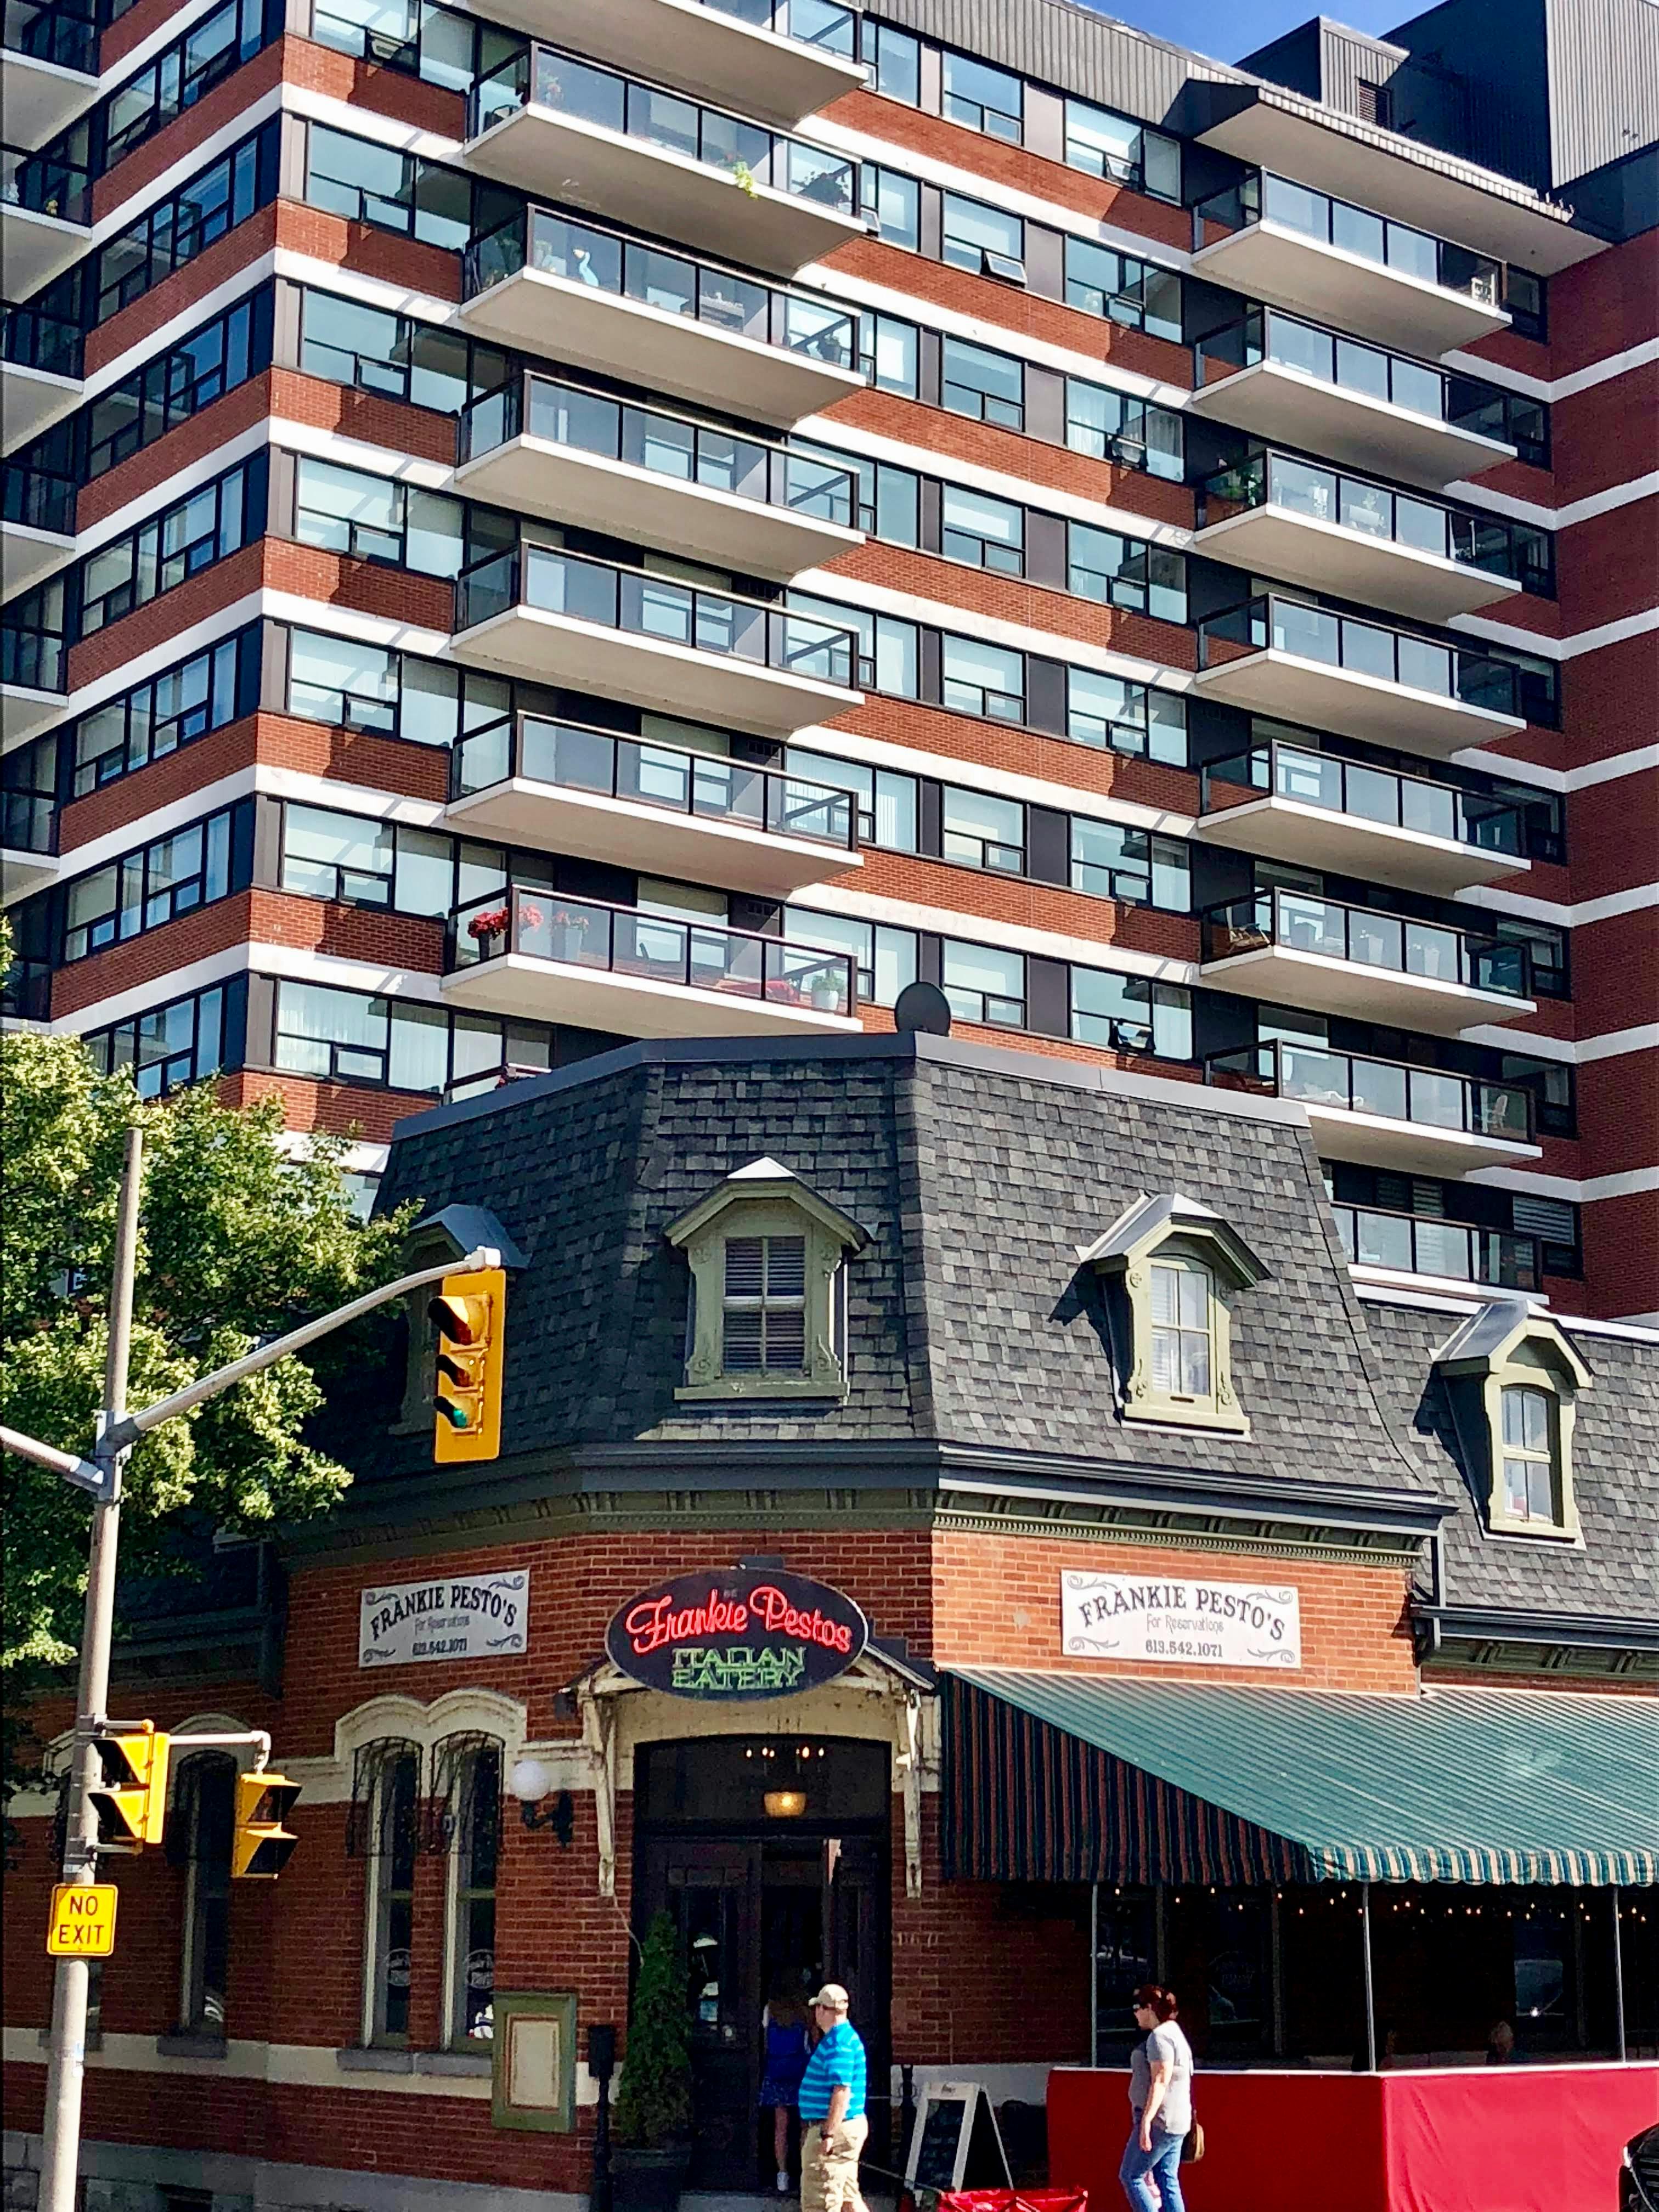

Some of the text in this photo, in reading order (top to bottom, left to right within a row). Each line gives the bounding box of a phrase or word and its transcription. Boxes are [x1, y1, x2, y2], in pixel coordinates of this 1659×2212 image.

[370, 1585, 517, 1641] FRANKIE PESTO'S
[626, 1589, 748, 1654] Frankie
[1079, 1585, 1285, 1640] FRANKIE PESTO'S
[1147, 1613, 1224, 1634] For Reservations
[672, 1647, 806, 1669] ITALIAN
[1146, 1639, 1223, 1657] 613.542.1071
[672, 1667, 805, 1690] EATERY
[70, 1895, 98, 1916] NO
[59, 1924, 105, 1945] EXIT
